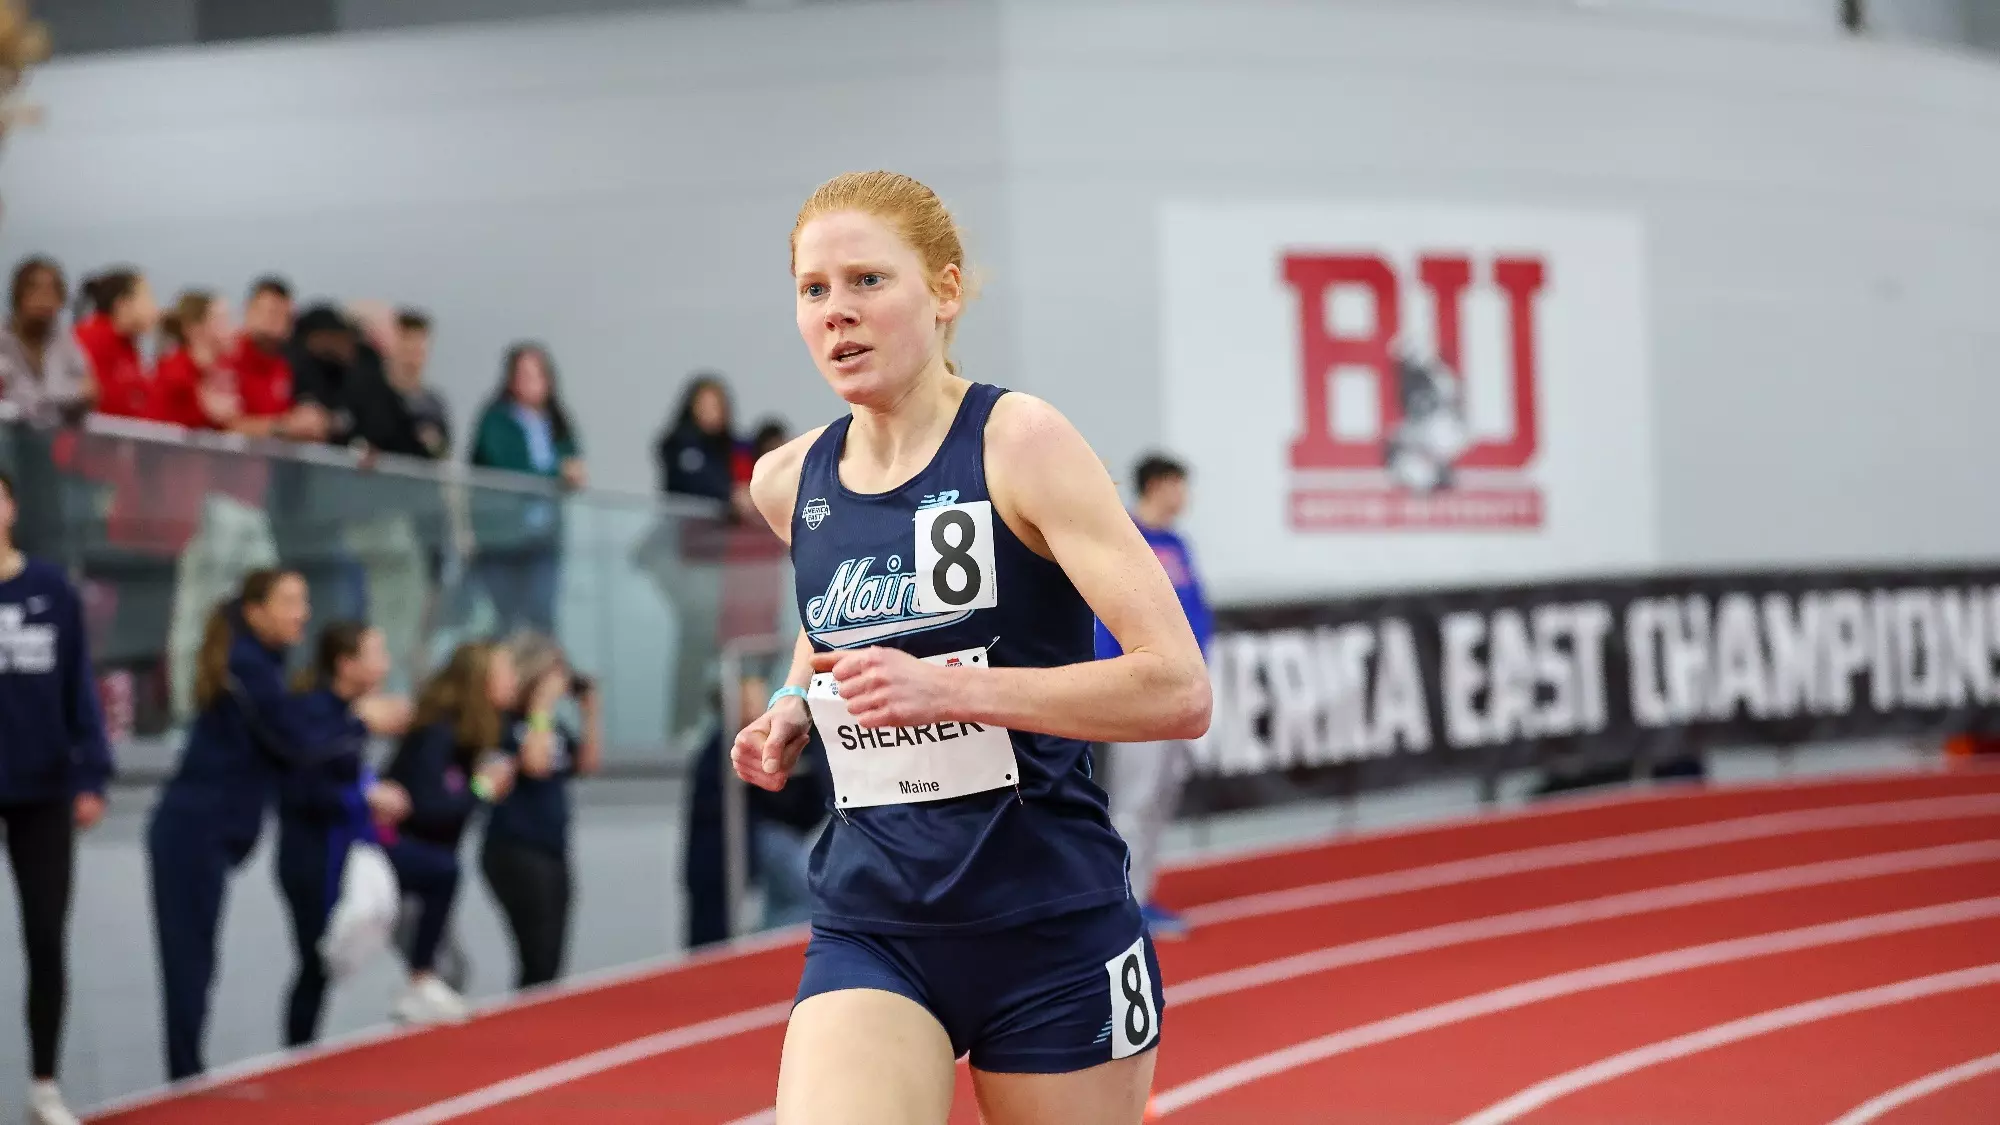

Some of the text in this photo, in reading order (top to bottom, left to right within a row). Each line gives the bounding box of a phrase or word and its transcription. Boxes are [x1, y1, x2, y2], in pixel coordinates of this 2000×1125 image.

[1281, 253, 1547, 470] BU
[931, 510, 981, 605] 8
[1441, 608, 1612, 746] EAST
[899, 779, 940, 794] Maine
[1121, 953, 1150, 1046] 8
